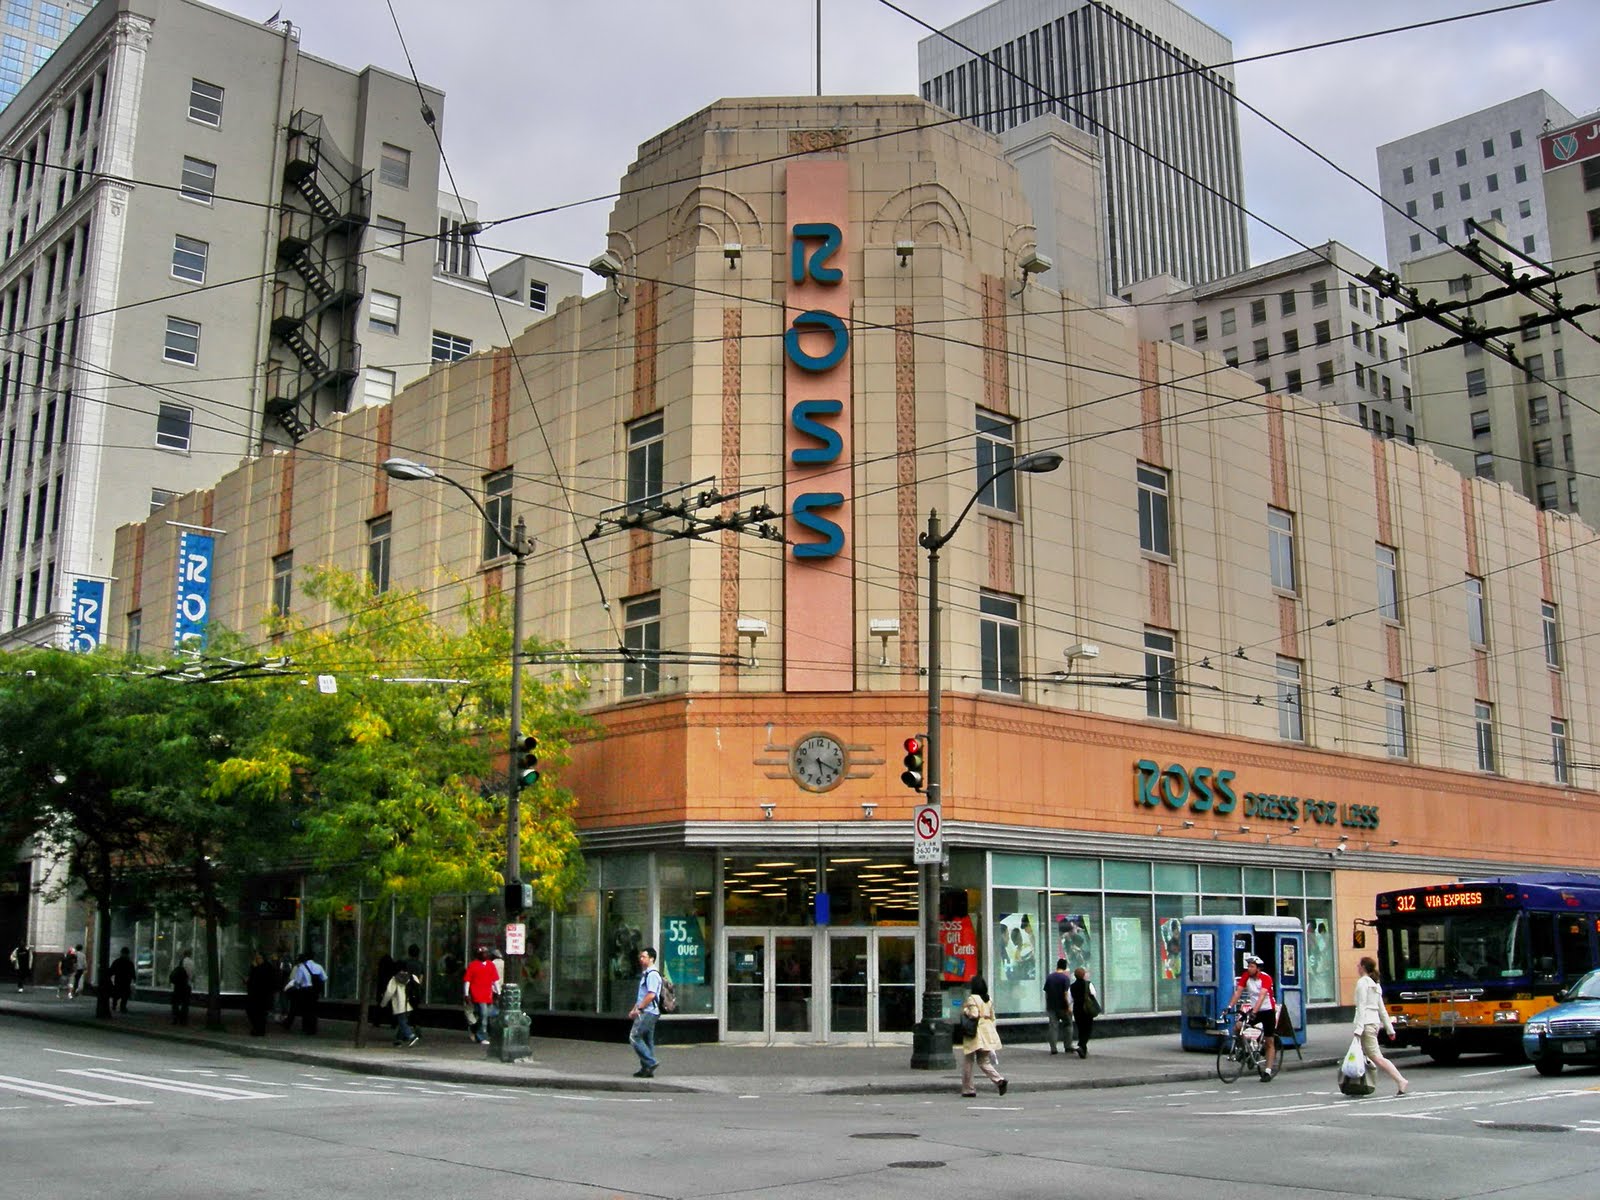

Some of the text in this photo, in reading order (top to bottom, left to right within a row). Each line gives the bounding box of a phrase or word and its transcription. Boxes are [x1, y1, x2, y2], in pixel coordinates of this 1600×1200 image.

[1587, 124, 1600, 140] J
[784, 223, 849, 560] ROSS
[834, 748, 839, 756] 2
[800, 767, 805, 775] 8
[807, 774, 813, 782] 7
[1134, 758, 1237, 815] ROSS
[1243, 792, 1379, 830] DRESS FOR LESS
[1397, 892, 1482, 911] 312 VIA EXPRESS
[669, 920, 687, 942] 55
[677, 944, 699, 956] over
[953, 944, 975, 955] Cards
